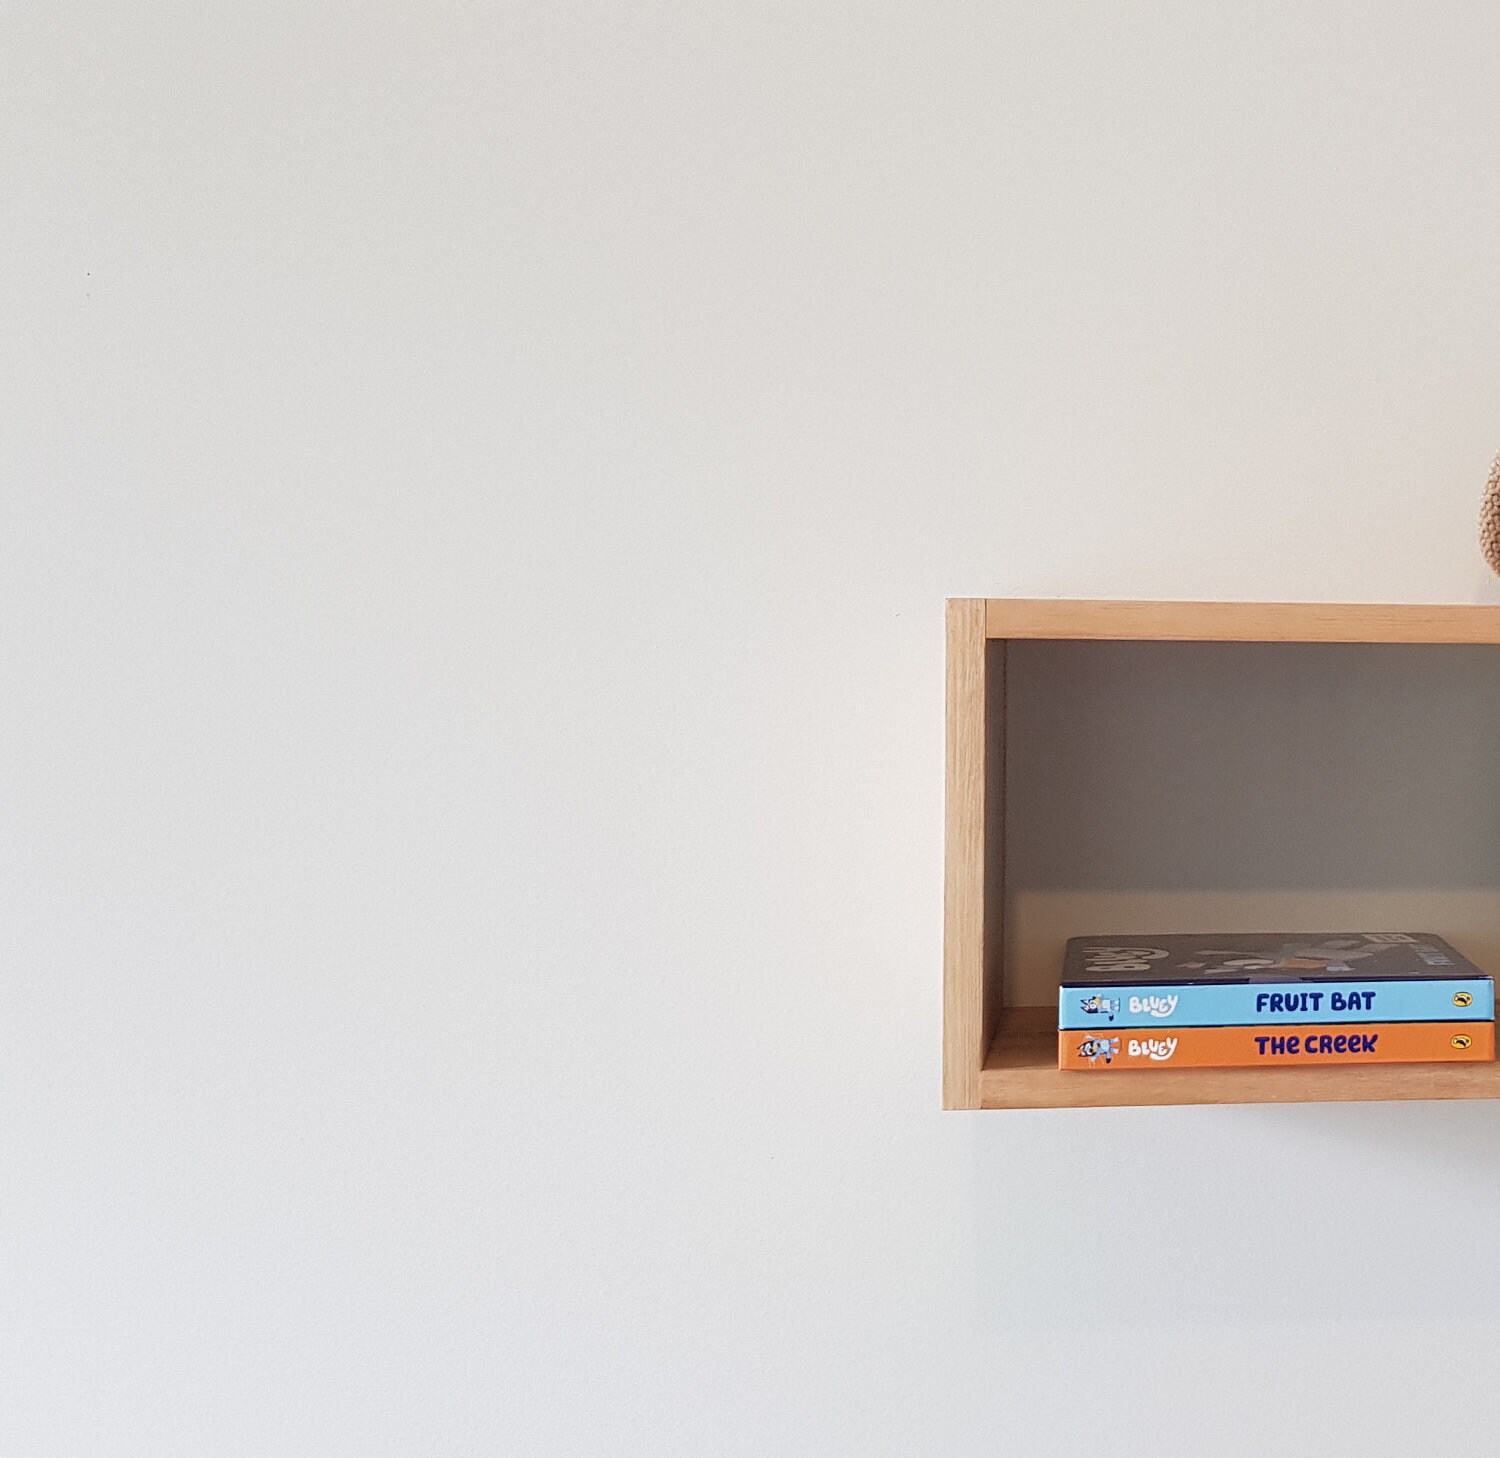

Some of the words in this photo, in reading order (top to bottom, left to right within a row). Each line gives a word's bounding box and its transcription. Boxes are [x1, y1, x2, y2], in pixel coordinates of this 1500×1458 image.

[1129, 994, 1179, 1018] BLUEY
[1256, 992, 1324, 1012] FRUIT
[1331, 991, 1376, 1011] BAT
[1128, 1037, 1178, 1061] BLUEY
